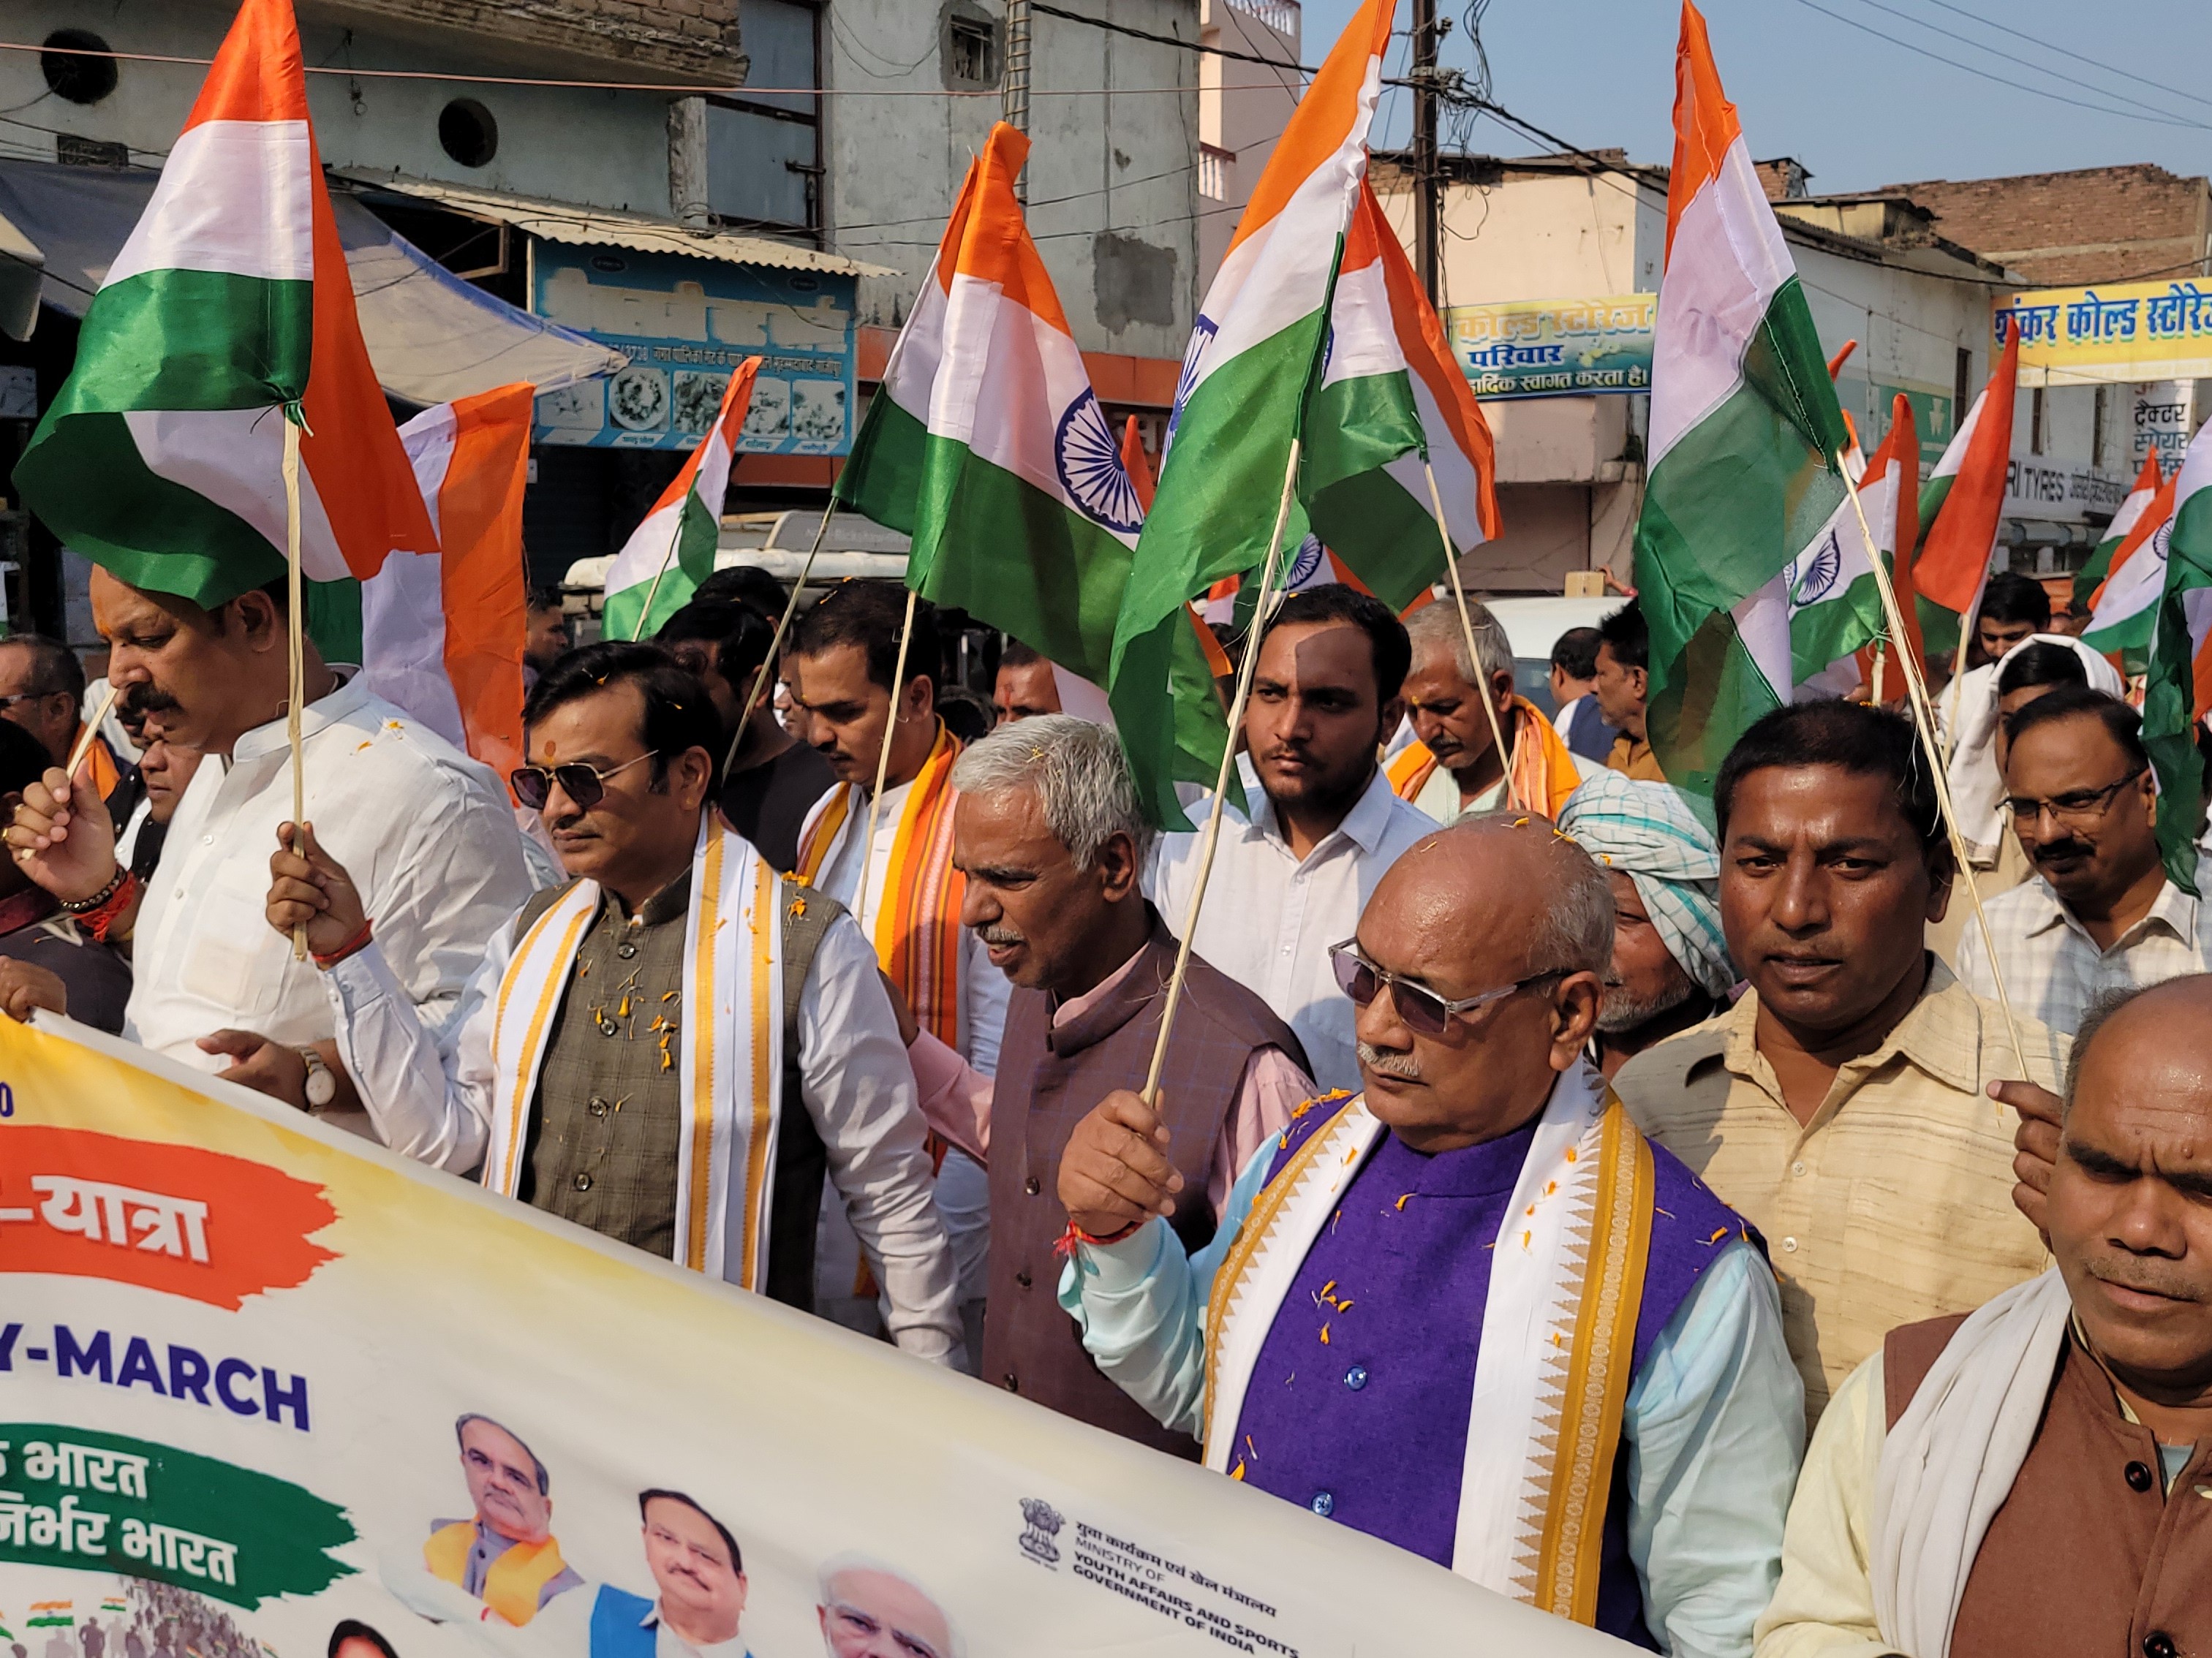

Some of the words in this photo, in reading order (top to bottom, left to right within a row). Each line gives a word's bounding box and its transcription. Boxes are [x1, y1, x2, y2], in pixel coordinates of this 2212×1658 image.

[1454, 308, 1543, 341] कोल्ड
[1549, 299, 1652, 337] स्टोरेज
[2067, 290, 2140, 341] कोल्ड
[1466, 344, 1564, 368] परिवार
[1520, 371, 1572, 393] स्वागत
[1576, 368, 1624, 387] करता
[2023, 467, 2066, 502] TYRES
[23, 1441, 149, 1499] भारत
[121, 1518, 238, 1586] भारत
[1076, 1521, 1103, 1542] युवा
[1164, 1559, 1186, 1578] एवं
[1189, 1570, 1220, 1593] खेल
[1076, 1536, 1142, 1573] MINISTRY
[1145, 1568, 1165, 1583] OF
[1073, 1564, 1180, 1620] GOVERNMENT
[1185, 1616, 1206, 1629] OF
[1209, 1626, 1255, 1655] INDIA
[1074, 1551, 1126, 1582] YOUTH
[1128, 1576, 1193, 1612] AFFAIRS
[1196, 1608, 1231, 1629] AND
[1234, 1624, 1299, 1658] SPORTS
